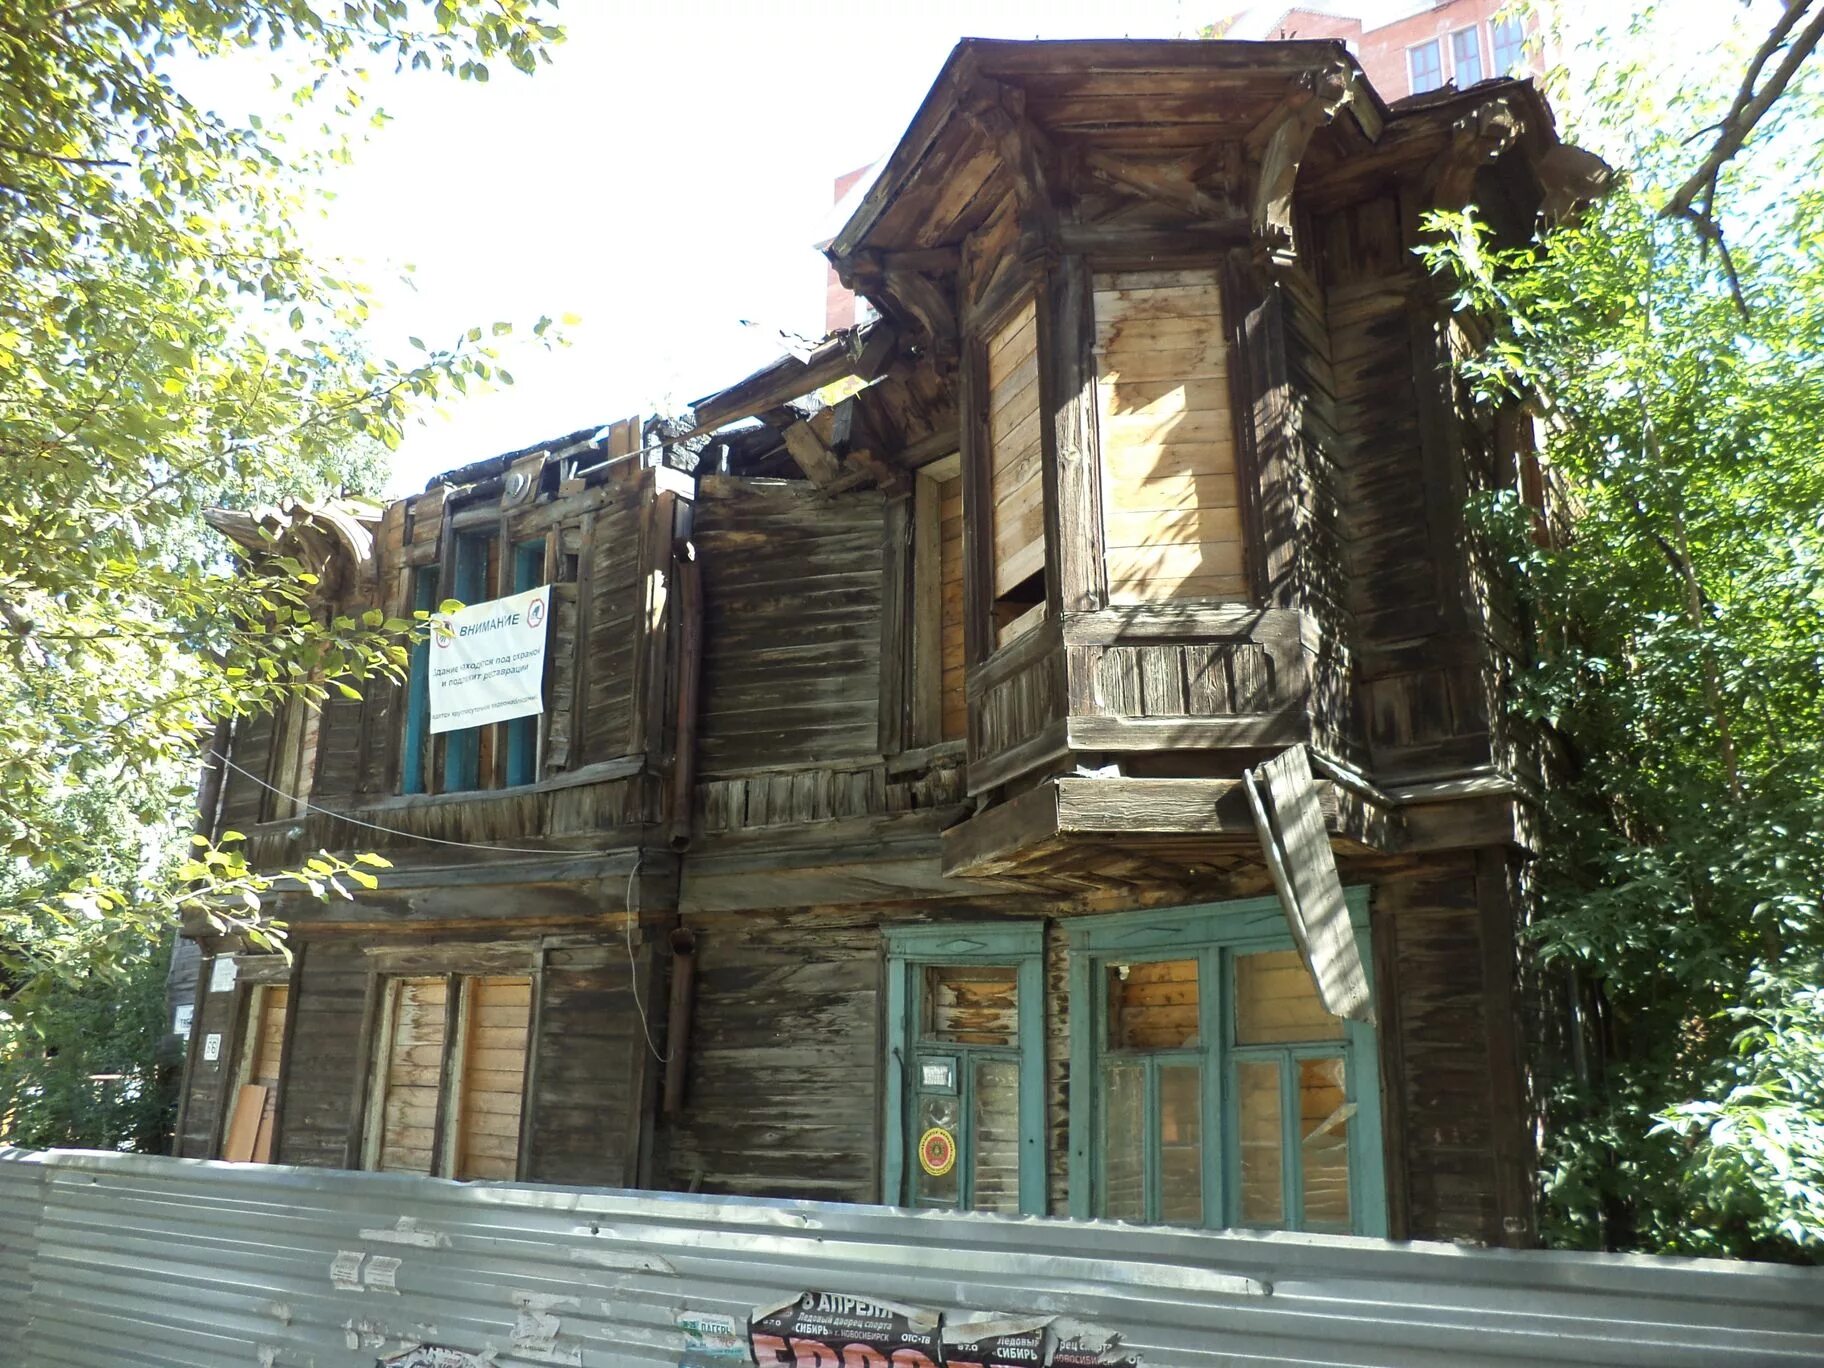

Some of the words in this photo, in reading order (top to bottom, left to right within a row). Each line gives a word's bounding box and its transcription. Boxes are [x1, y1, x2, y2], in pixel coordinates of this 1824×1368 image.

[459, 613, 520, 637] ВНИМАНИЕ
[460, 658, 493, 671] аходится
[495, 655, 511, 665] под
[448, 672, 482, 686] поджит
[482, 665, 528, 680] реставрации
[797, 1311, 833, 1324] Ледовый
[833, 1317, 864, 1330] дворец
[864, 1321, 892, 1331] спорта
[841, 1329, 890, 1342] НОВОСИБИРСК
